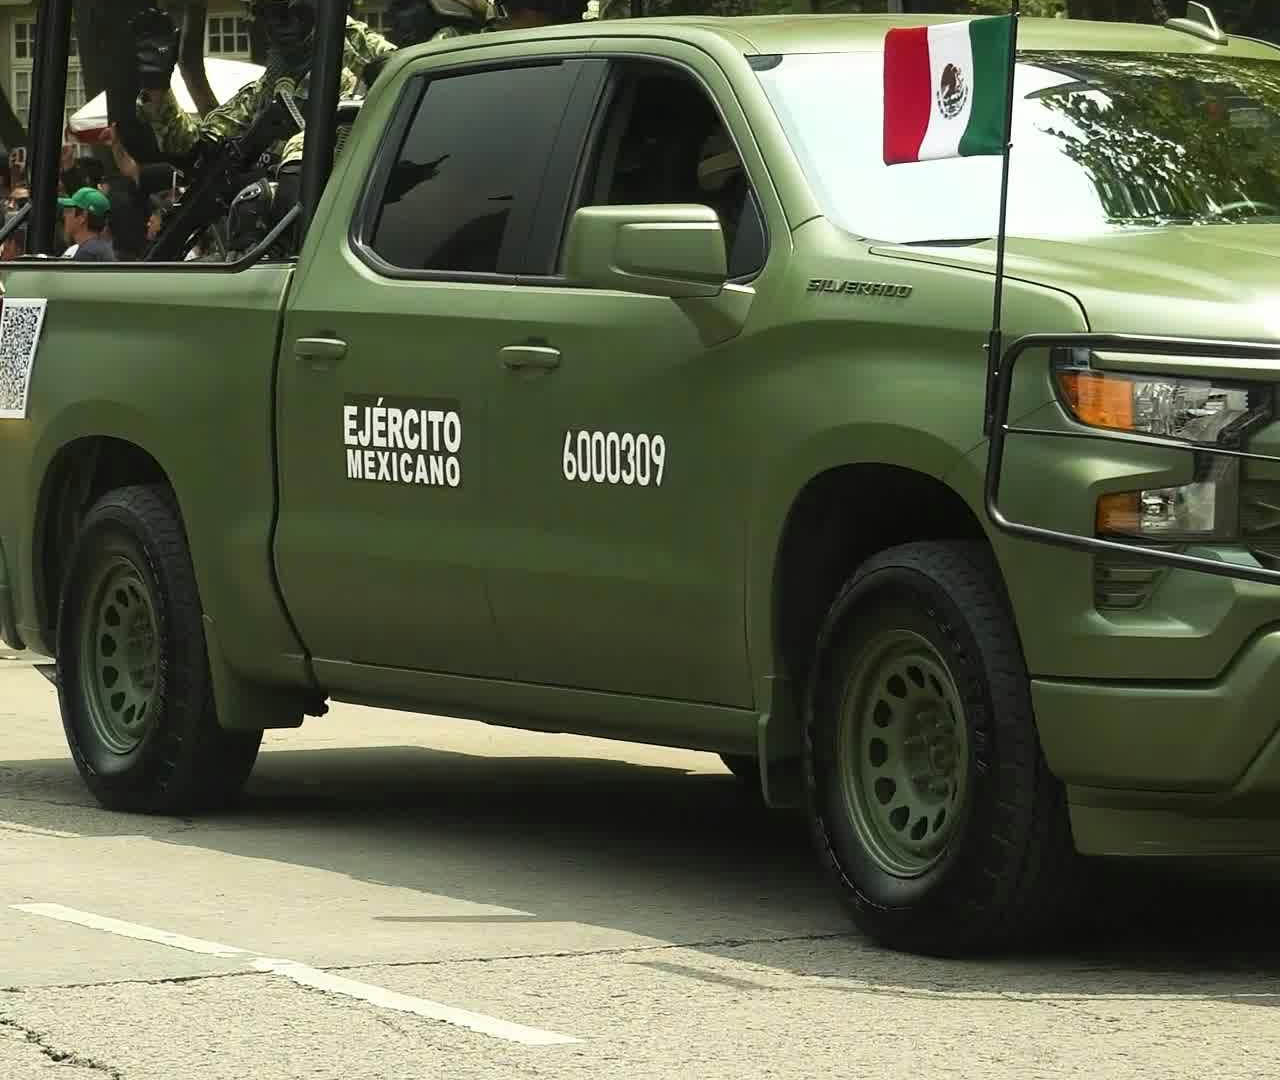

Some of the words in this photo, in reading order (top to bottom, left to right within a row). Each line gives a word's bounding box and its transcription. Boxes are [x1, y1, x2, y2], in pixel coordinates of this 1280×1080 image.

[806, 279, 913, 299] SILVERADO
[343, 397, 462, 454] EJÉRCITO
[346, 448, 461, 488] MEXICANO
[563, 430, 666, 487] 6000309
